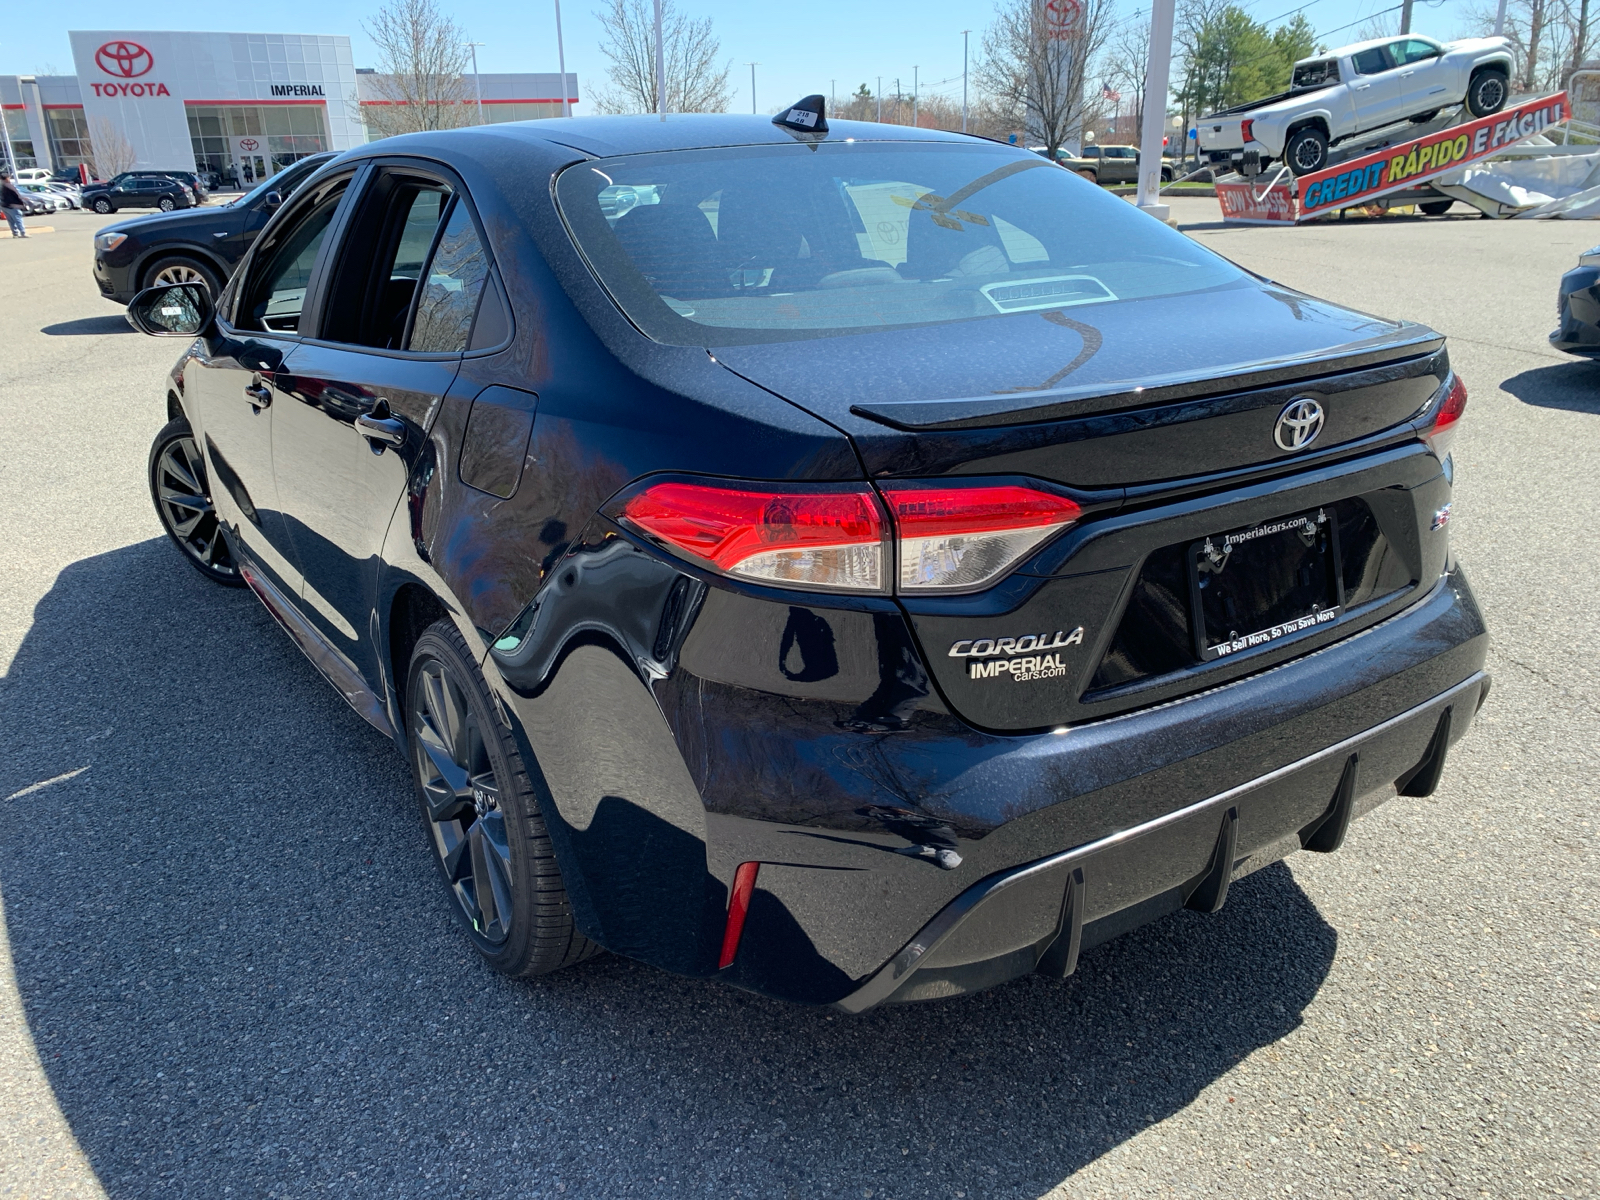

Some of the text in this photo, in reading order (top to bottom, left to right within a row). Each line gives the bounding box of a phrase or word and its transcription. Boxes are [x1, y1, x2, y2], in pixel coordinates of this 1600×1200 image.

[91, 83, 170, 97] TOYOTA
[271, 85, 325, 96] IMPERIAL
[1304, 161, 1386, 209] CREDIT
[1388, 134, 1469, 183] RÁPIDO
[1473, 126, 1489, 154] E
[1225, 517, 1308, 544] Imperialcars.com
[948, 626, 1084, 657] COROLLA
[1217, 611, 1335, 656] We Sell More, So You Save More
[970, 654, 1066, 679] IMPERIAL
[1014, 666, 1066, 682] cars.com
